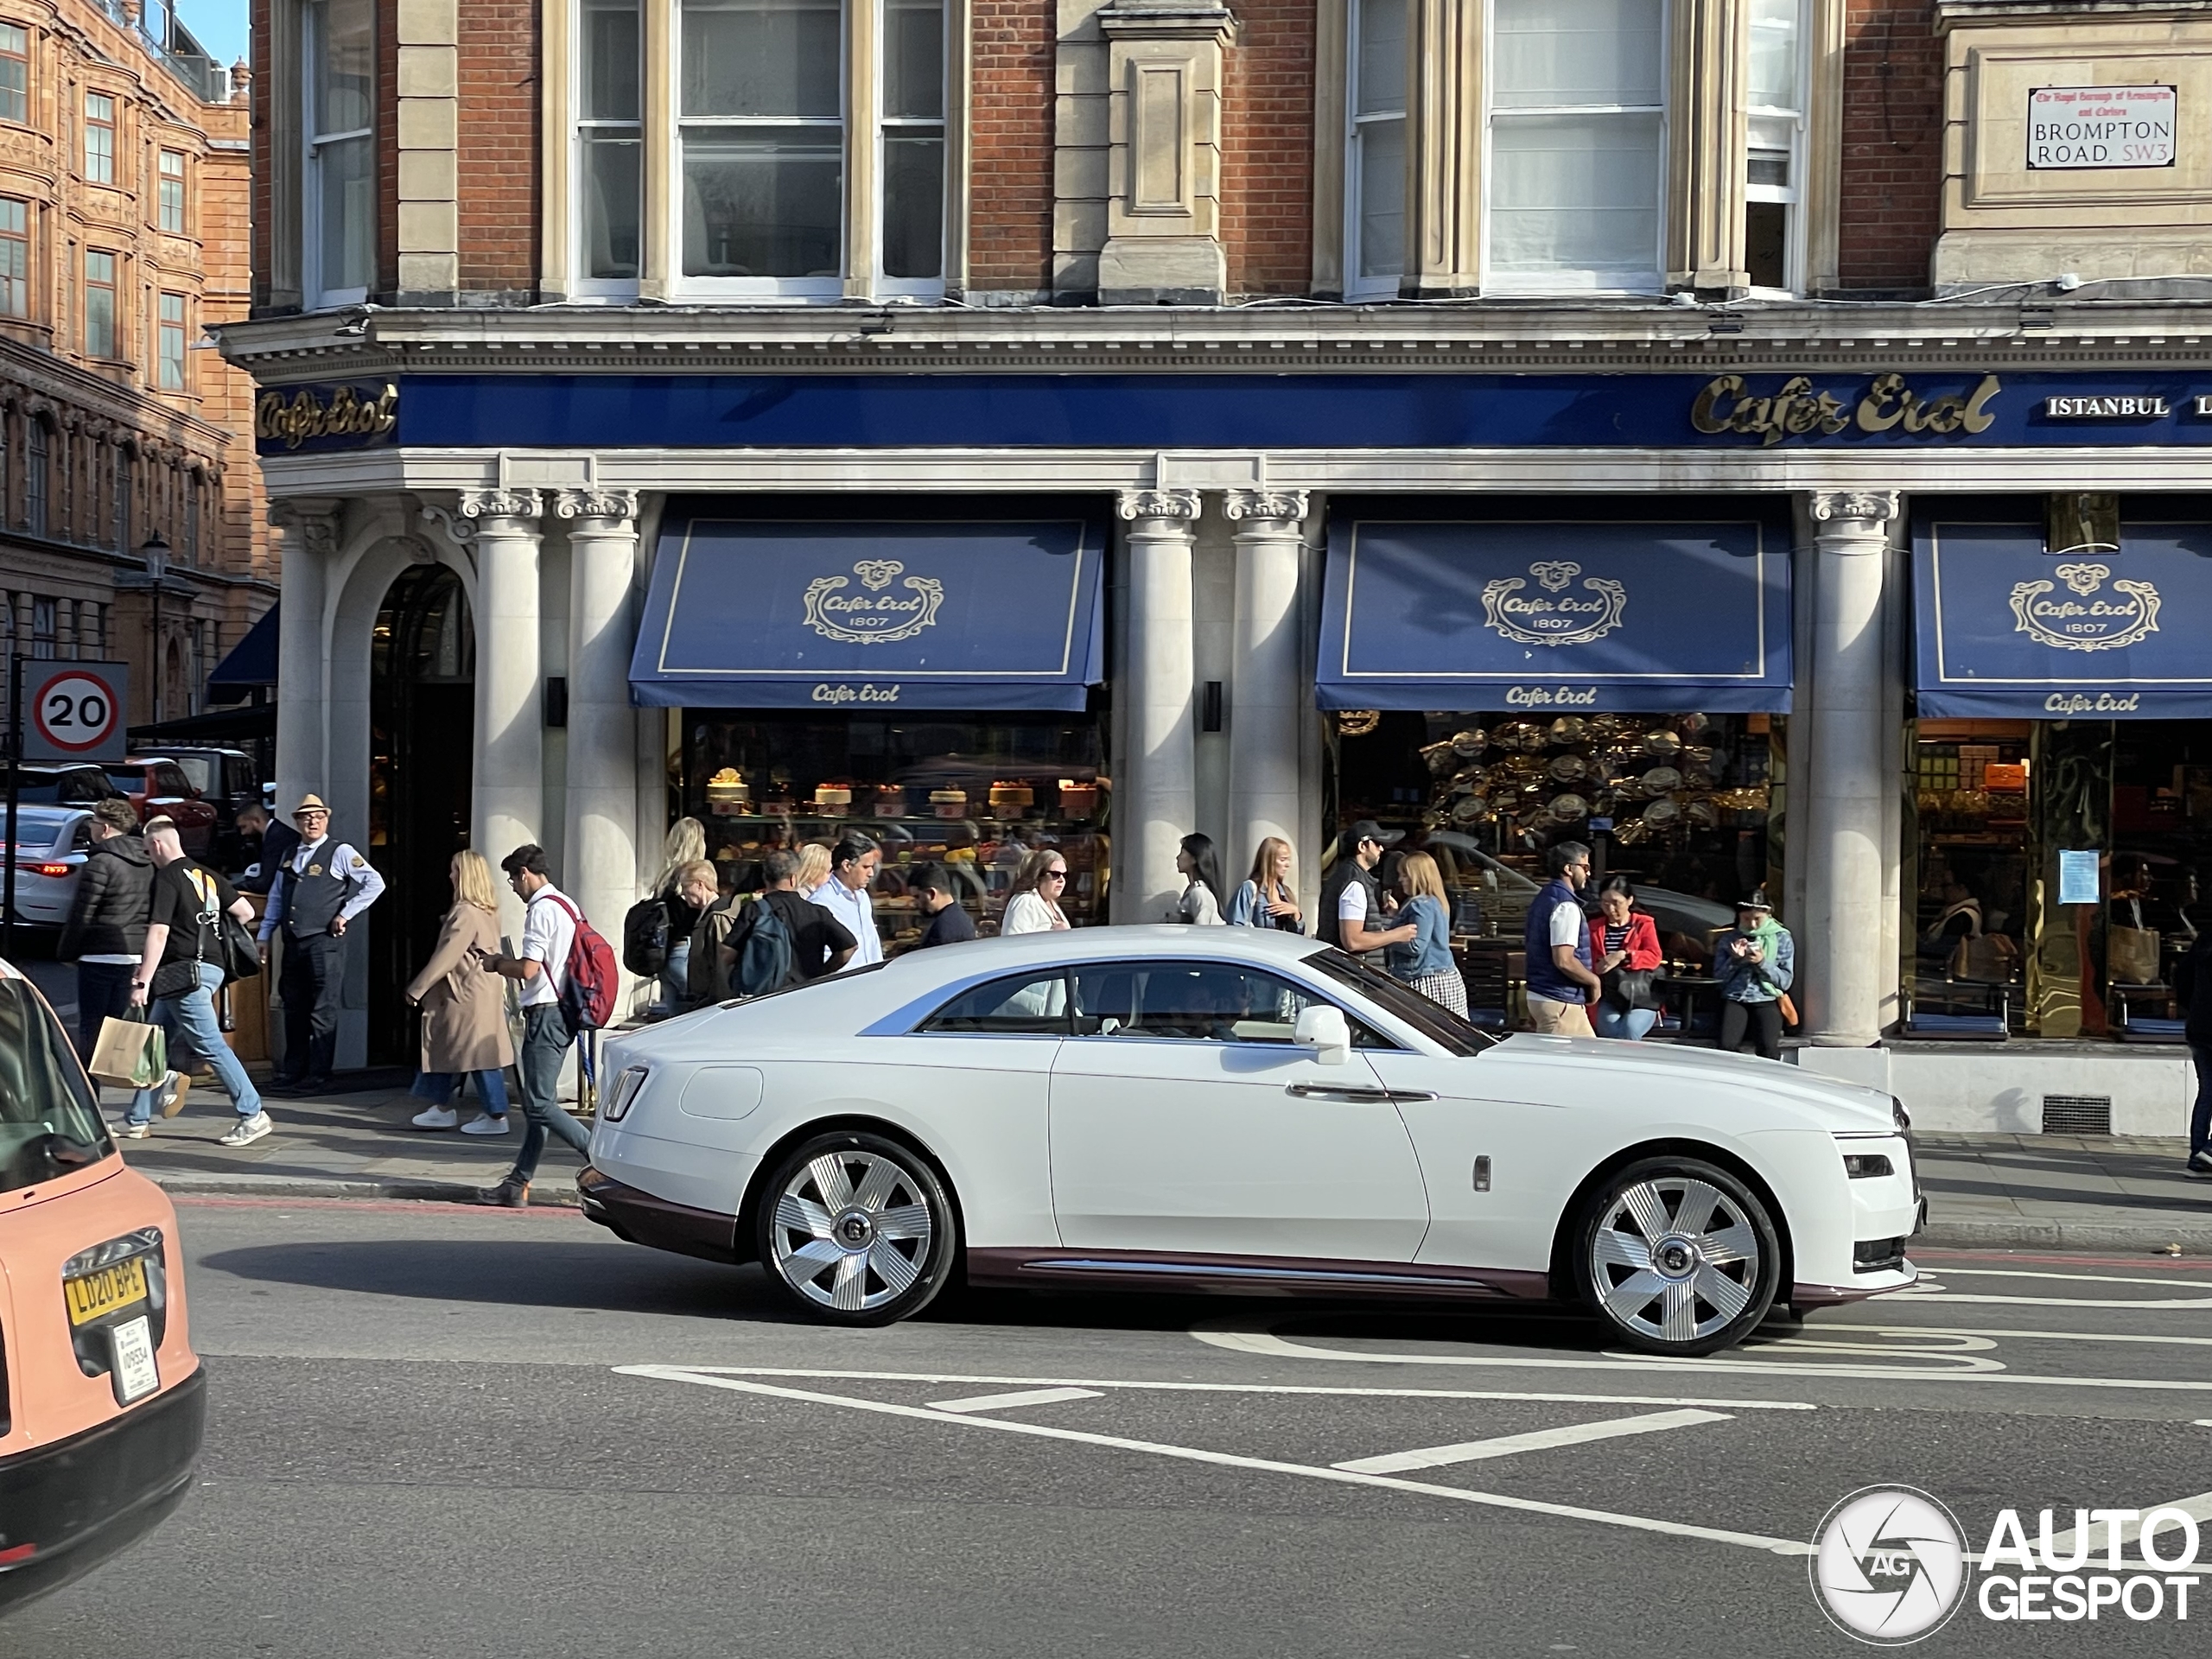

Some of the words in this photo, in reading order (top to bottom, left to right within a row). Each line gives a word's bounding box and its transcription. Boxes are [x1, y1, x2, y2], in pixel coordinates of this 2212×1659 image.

[2035, 121, 2170, 141] BROMPTON
[1856, 372, 2002, 434] Erol
[2048, 397, 2171, 416] ISTANBUL
[823, 595, 874, 613] Cafer
[875, 595, 922, 611] Erol
[1503, 597, 1556, 614] Cafer
[1558, 597, 1605, 613] Erol
[2033, 601, 2088, 619] Cafer
[2089, 601, 2138, 616] Erol
[849, 618, 889, 626] 1807
[1533, 619, 1574, 628] 1807
[2065, 624, 2108, 632] 1807
[811, 683, 857, 705] Cafer
[859, 683, 900, 702] Erol
[1505, 686, 1553, 708] Cafer
[1554, 686, 1598, 704] Erol
[48, 694, 106, 728] 20
[2044, 693, 2094, 715] Cafer
[2095, 693, 2140, 712] Erol
